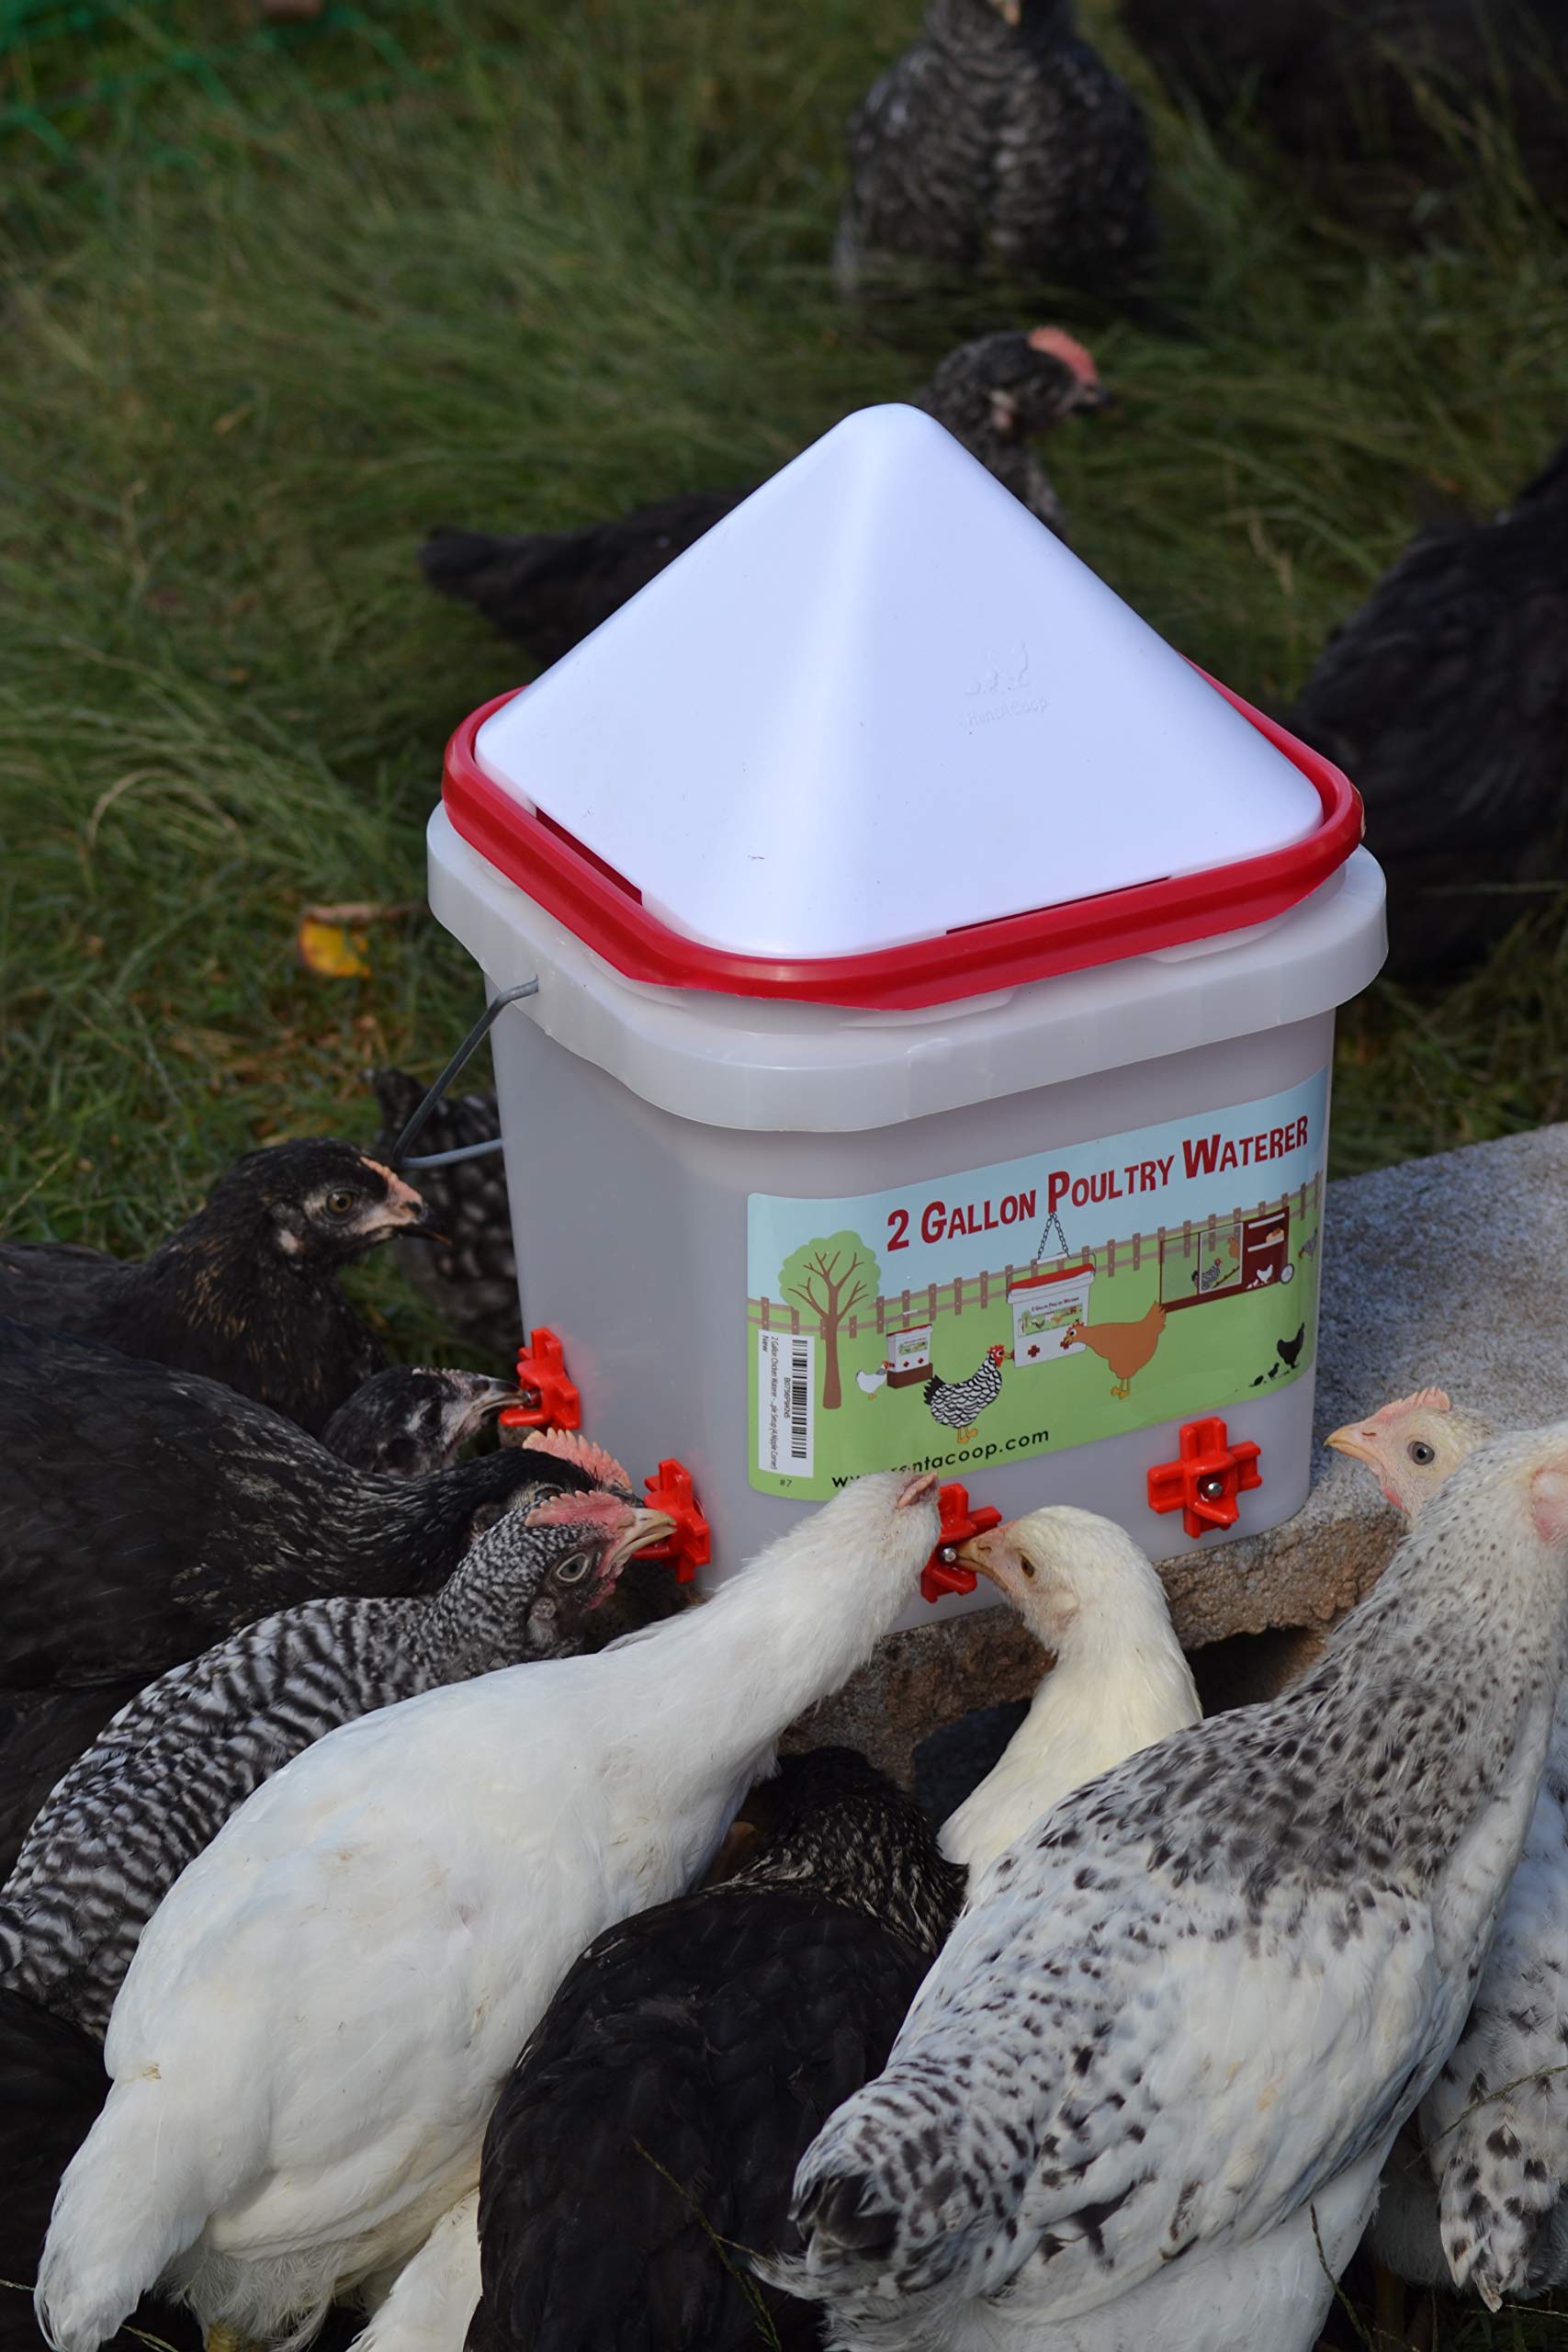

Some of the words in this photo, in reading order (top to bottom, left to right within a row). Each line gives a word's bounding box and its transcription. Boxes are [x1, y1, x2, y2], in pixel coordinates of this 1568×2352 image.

[887, 1209, 909, 1252] 2
[771, 1340, 779, 1357] Gallon
[771, 1358, 779, 1377] Chicken
